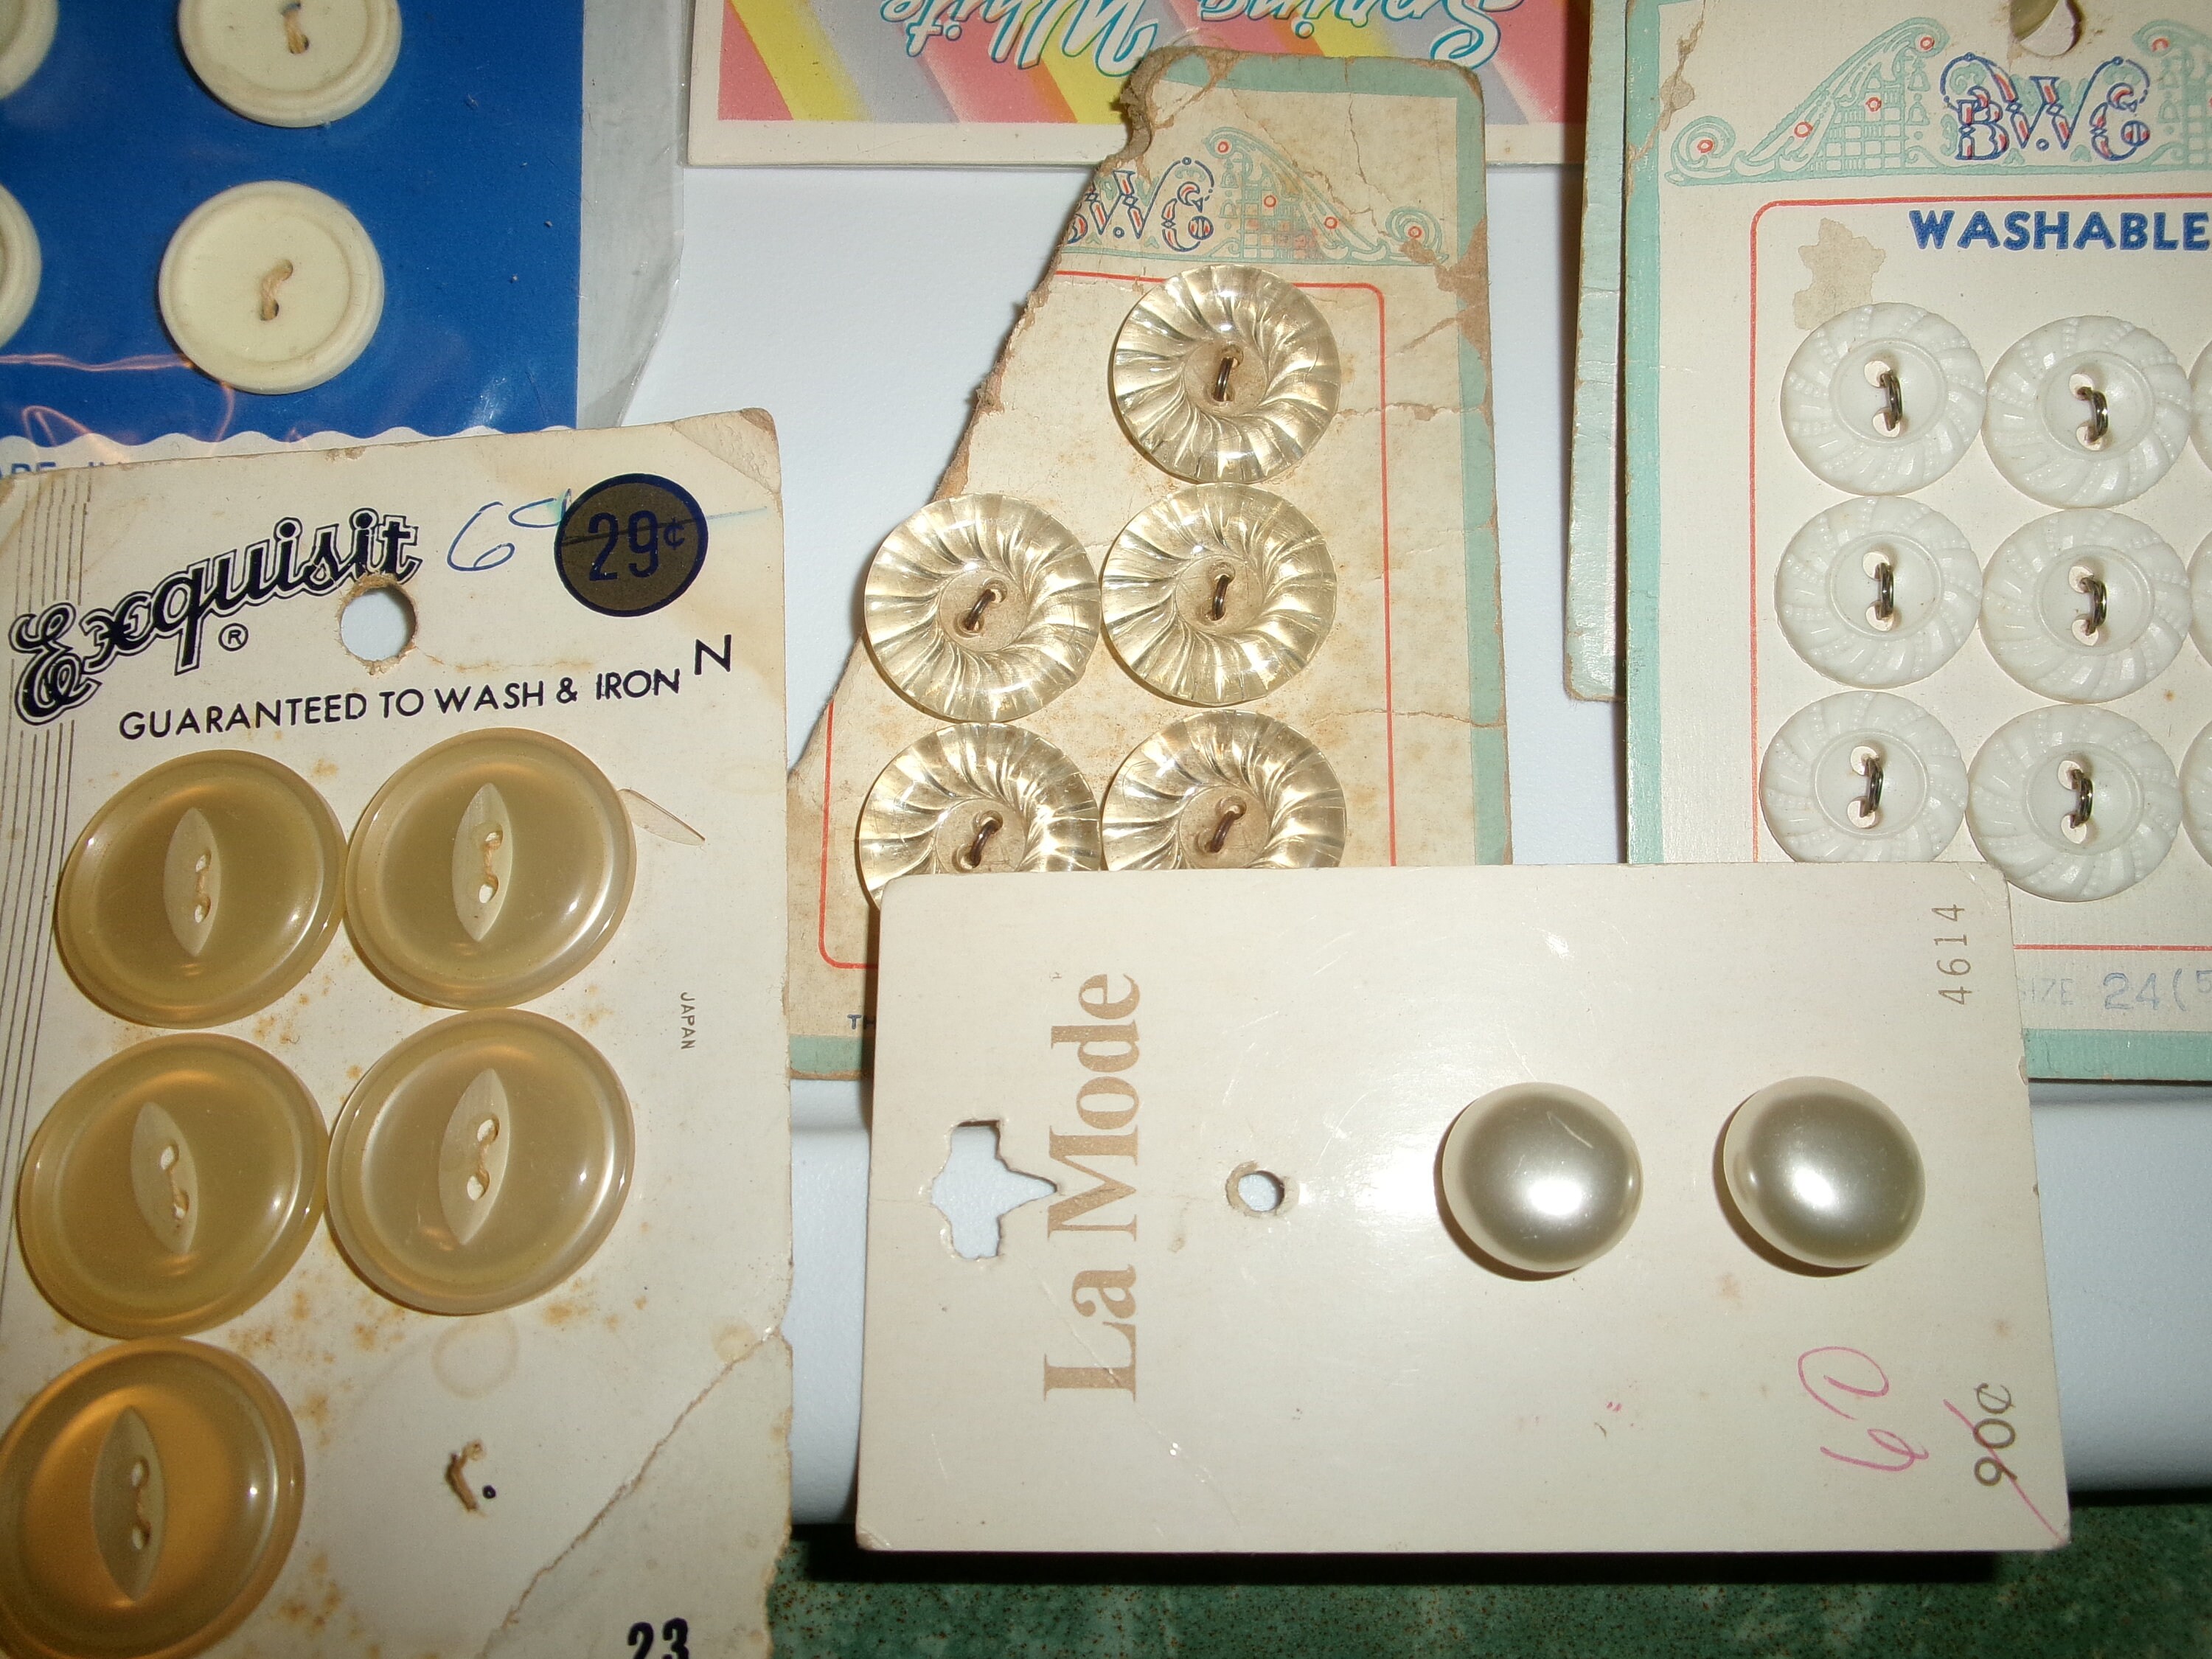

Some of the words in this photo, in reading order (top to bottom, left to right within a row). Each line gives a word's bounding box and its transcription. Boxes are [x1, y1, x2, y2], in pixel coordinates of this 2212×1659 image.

[1908, 209, 2211, 251] WASHABLE
[8, 507, 423, 726] Exquisit
[694, 634, 731, 675] N
[119, 692, 367, 740] GUARANTEED
[379, 688, 425, 719] TO
[434, 681, 543, 714] WASH
[556, 677, 578, 704] &
[595, 668, 681, 700] IRON
[1931, 903, 1972, 1005] 4614
[680, 991, 696, 1050] JAPAN
[1047, 973, 1141, 1242] Mode
[1043, 1265, 1138, 1402] La
[627, 1617, 689, 1659] 23
